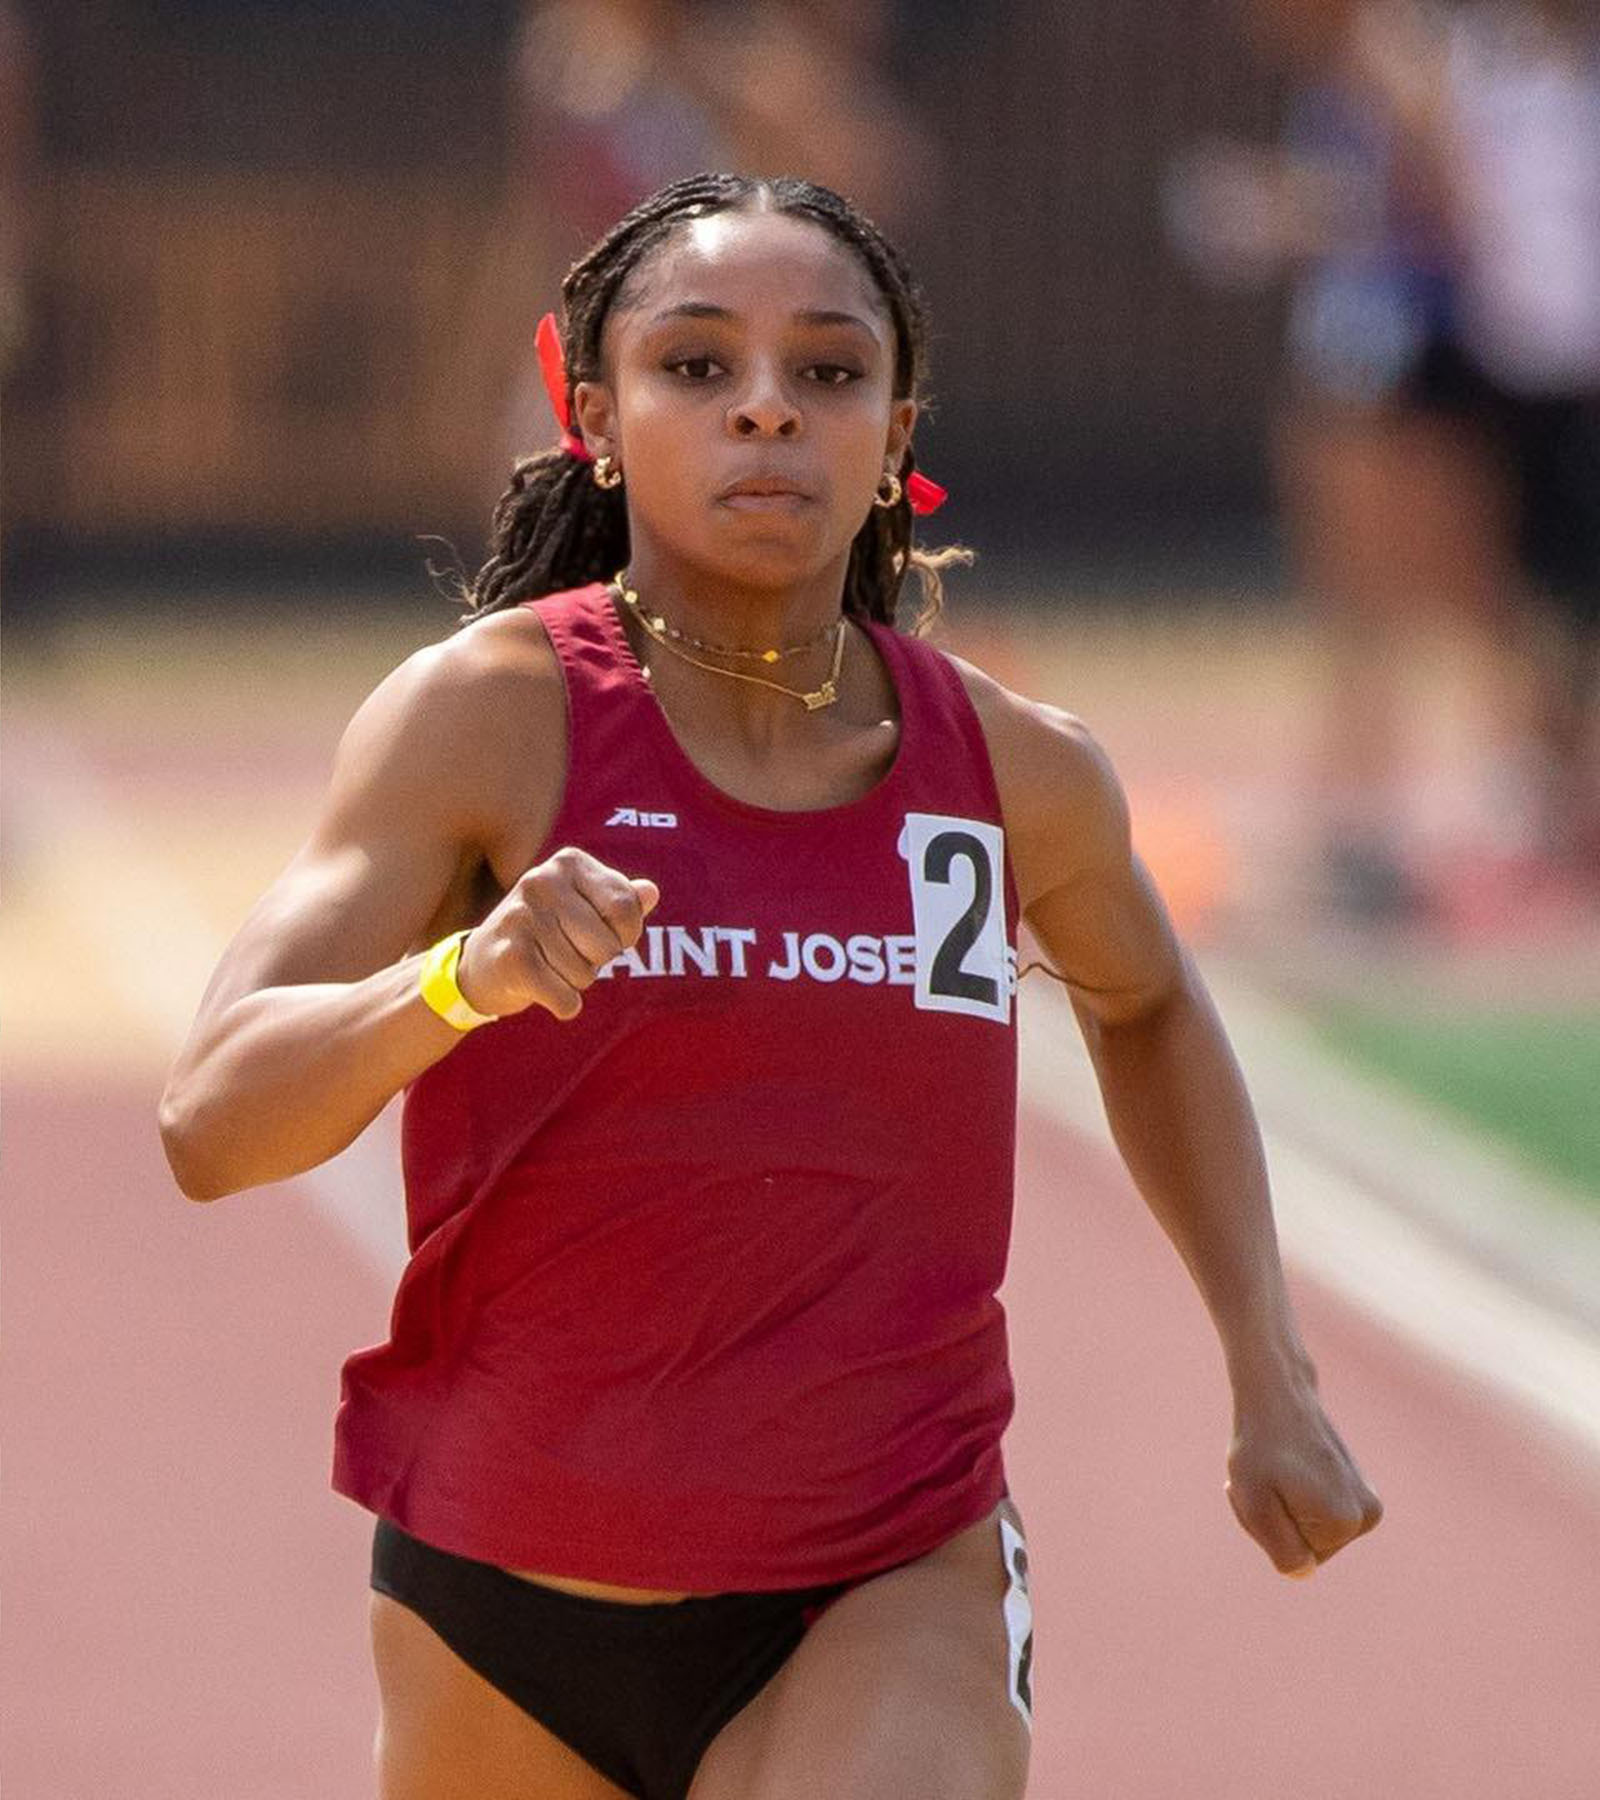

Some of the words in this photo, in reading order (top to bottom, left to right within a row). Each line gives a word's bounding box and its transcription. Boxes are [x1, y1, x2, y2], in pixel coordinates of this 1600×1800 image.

[606, 807, 678, 829] A10
[924, 831, 999, 1006] 2
[597, 925, 757, 979] AINT
